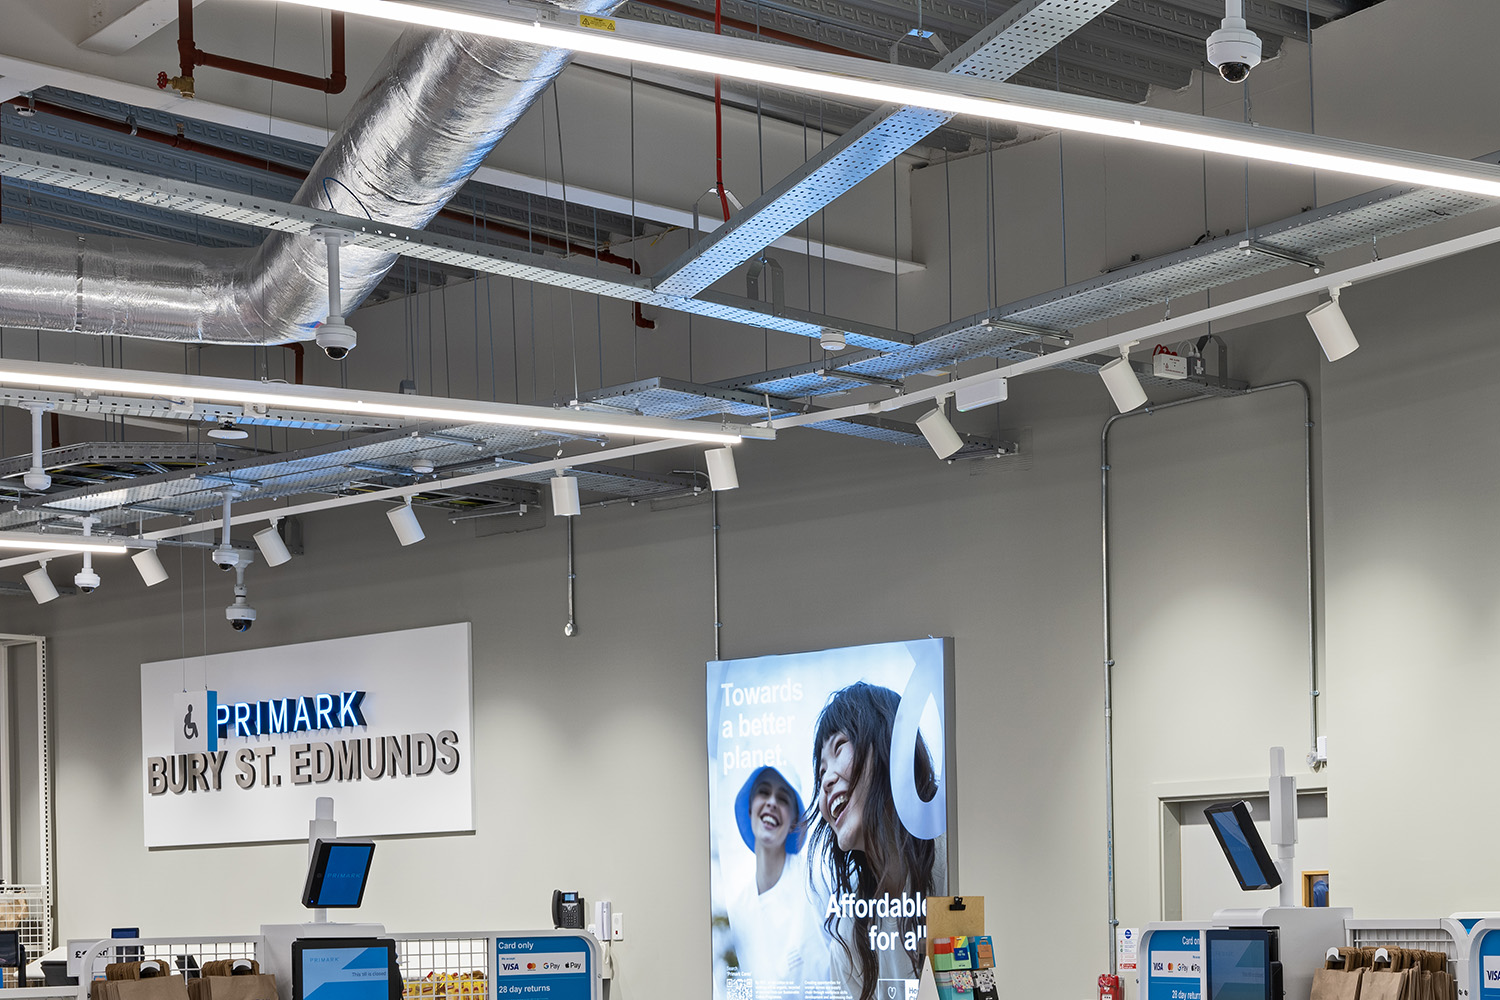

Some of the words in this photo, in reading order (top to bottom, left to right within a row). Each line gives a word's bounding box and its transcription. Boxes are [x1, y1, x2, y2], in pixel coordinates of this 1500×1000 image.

[721, 677, 803, 707] Towards
[217, 690, 366, 739] PRIMARK
[722, 719, 733, 738] a
[738, 712, 796, 737] better
[148, 750, 228, 795] BURY
[235, 746, 281, 789] ST.
[290, 730, 460, 785] EDMUNDS
[723, 744, 787, 775] planet.
[498, 941, 516, 950] Card
[517, 941, 534, 950] only
[869, 925, 899, 951] for
[1182, 936, 1194, 945] Card
[502, 963, 519, 971] VISA
[1153, 962, 1164, 971] VISA
[499, 985, 507, 993] 28
[509, 985, 522, 995] day
[524, 984, 551, 993] returns
[1178, 990, 1187, 1000] day
